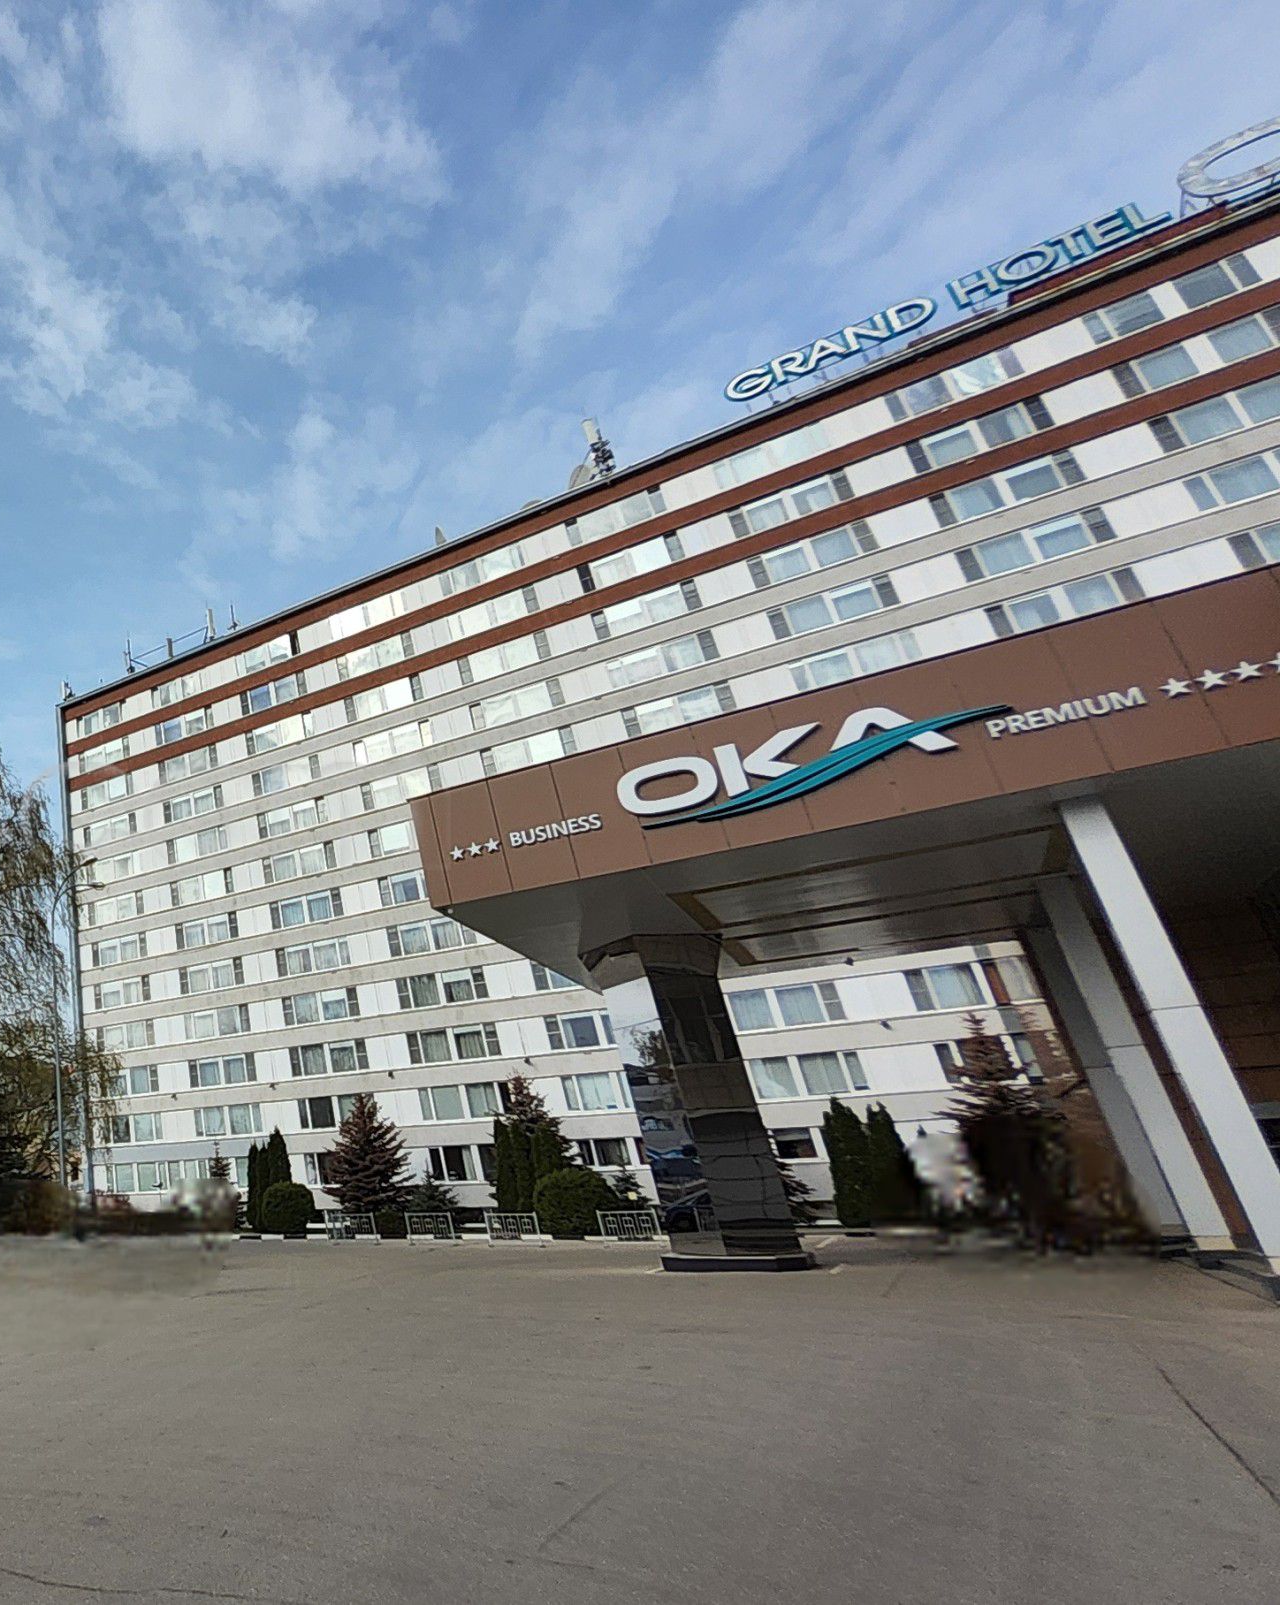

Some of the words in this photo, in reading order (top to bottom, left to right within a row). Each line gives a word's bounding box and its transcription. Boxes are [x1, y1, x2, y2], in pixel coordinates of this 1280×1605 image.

[724, 297, 938, 402] GRAND
[945, 202, 1172, 311] HOTEL
[984, 686, 1148, 740] PREMIUM
[616, 706, 960, 817] OKA
[509, 803, 602, 849] BUSINESS
